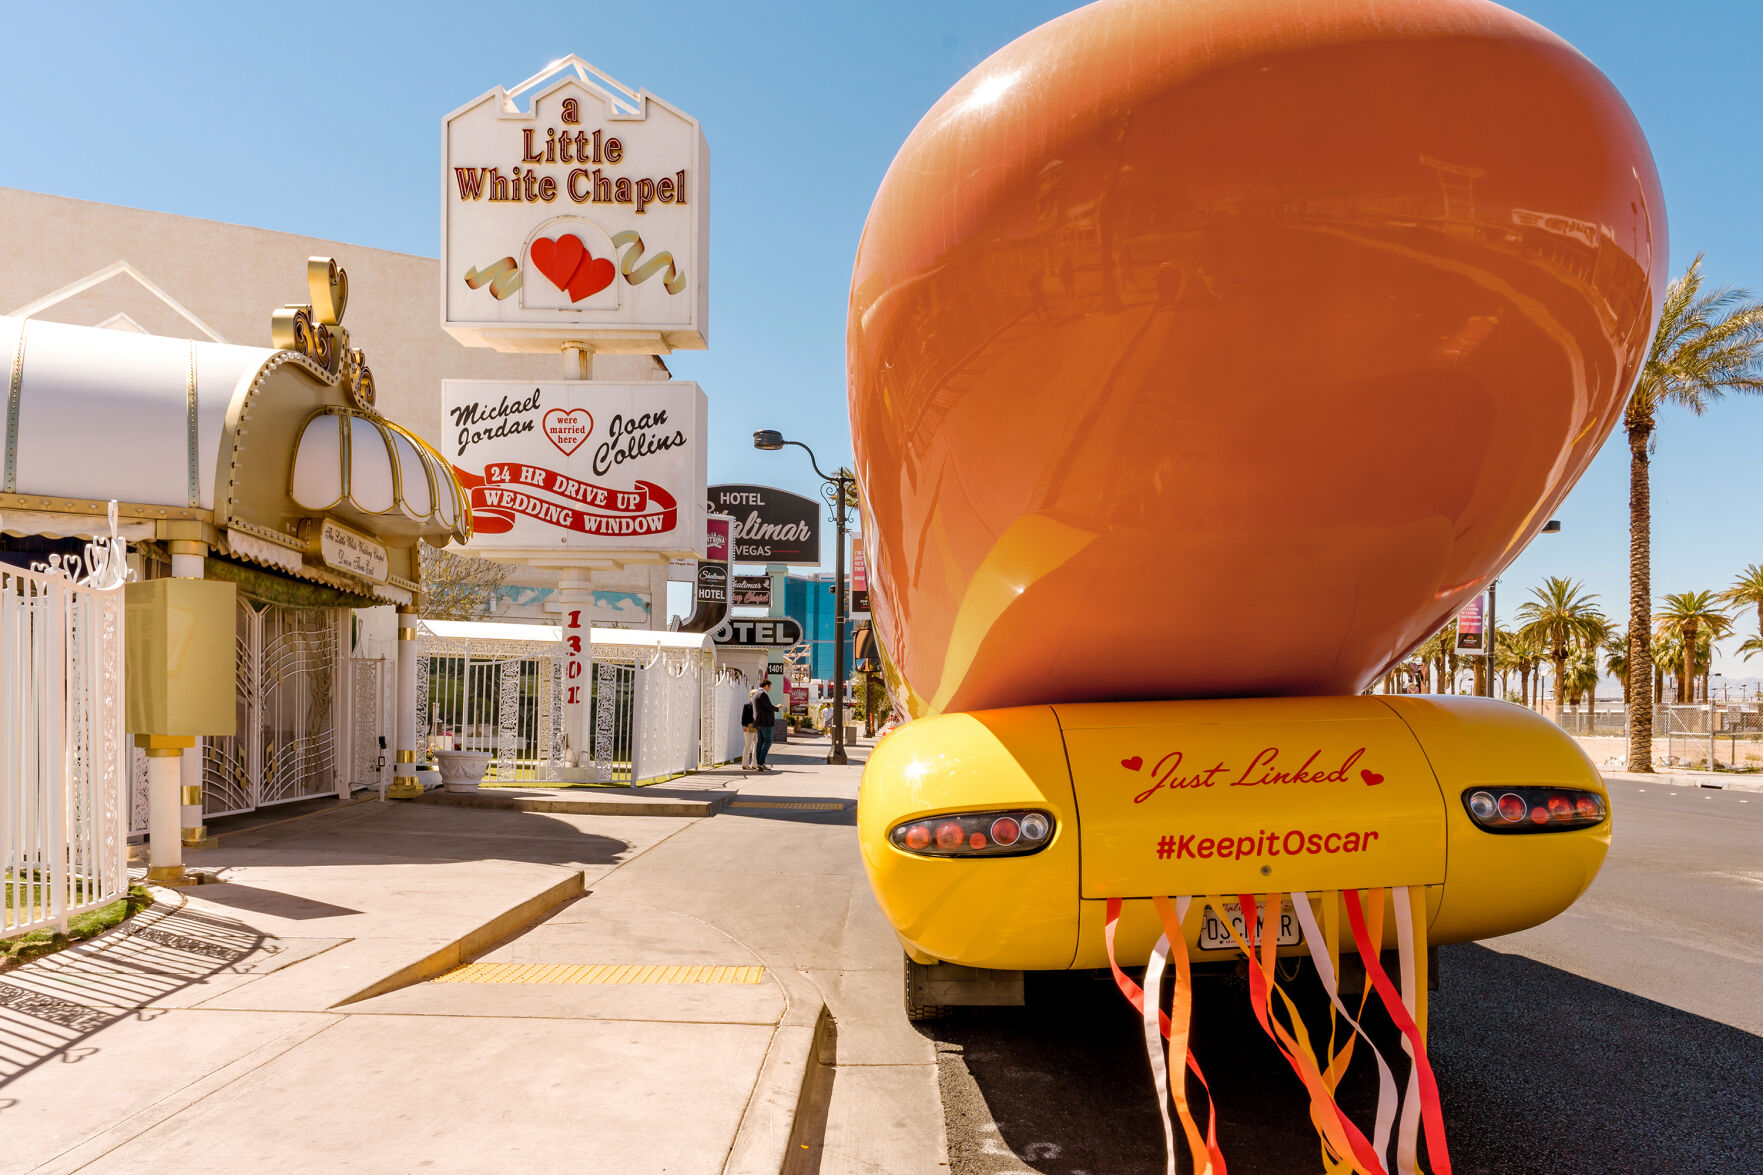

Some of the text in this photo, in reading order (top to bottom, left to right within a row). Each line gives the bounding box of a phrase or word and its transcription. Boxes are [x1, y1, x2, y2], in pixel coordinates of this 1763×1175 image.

[561, 98, 579, 124] a
[522, 127, 623, 165] Little
[454, 166, 688, 214] White Chapel
[450, 388, 541, 427] Michael
[557, 416, 578, 425] were
[457, 419, 535, 456] Jordan
[550, 425, 586, 435] married
[557, 435, 578, 444] here
[609, 409, 668, 451] Joan
[592, 430, 688, 476] Collins
[490, 466, 641, 511] 24 HR DRIVE UP
[720, 492, 766, 505] HOTEL
[483, 489, 665, 534] WEDDING WINDOW
[735, 545, 771, 557] VEGAS
[698, 588, 726, 600] HOTEL
[768, 664, 783, 673] 1401
[1133, 747, 1366, 804] Just Linked
[1156, 829, 1379, 861] #KeepitOscar
